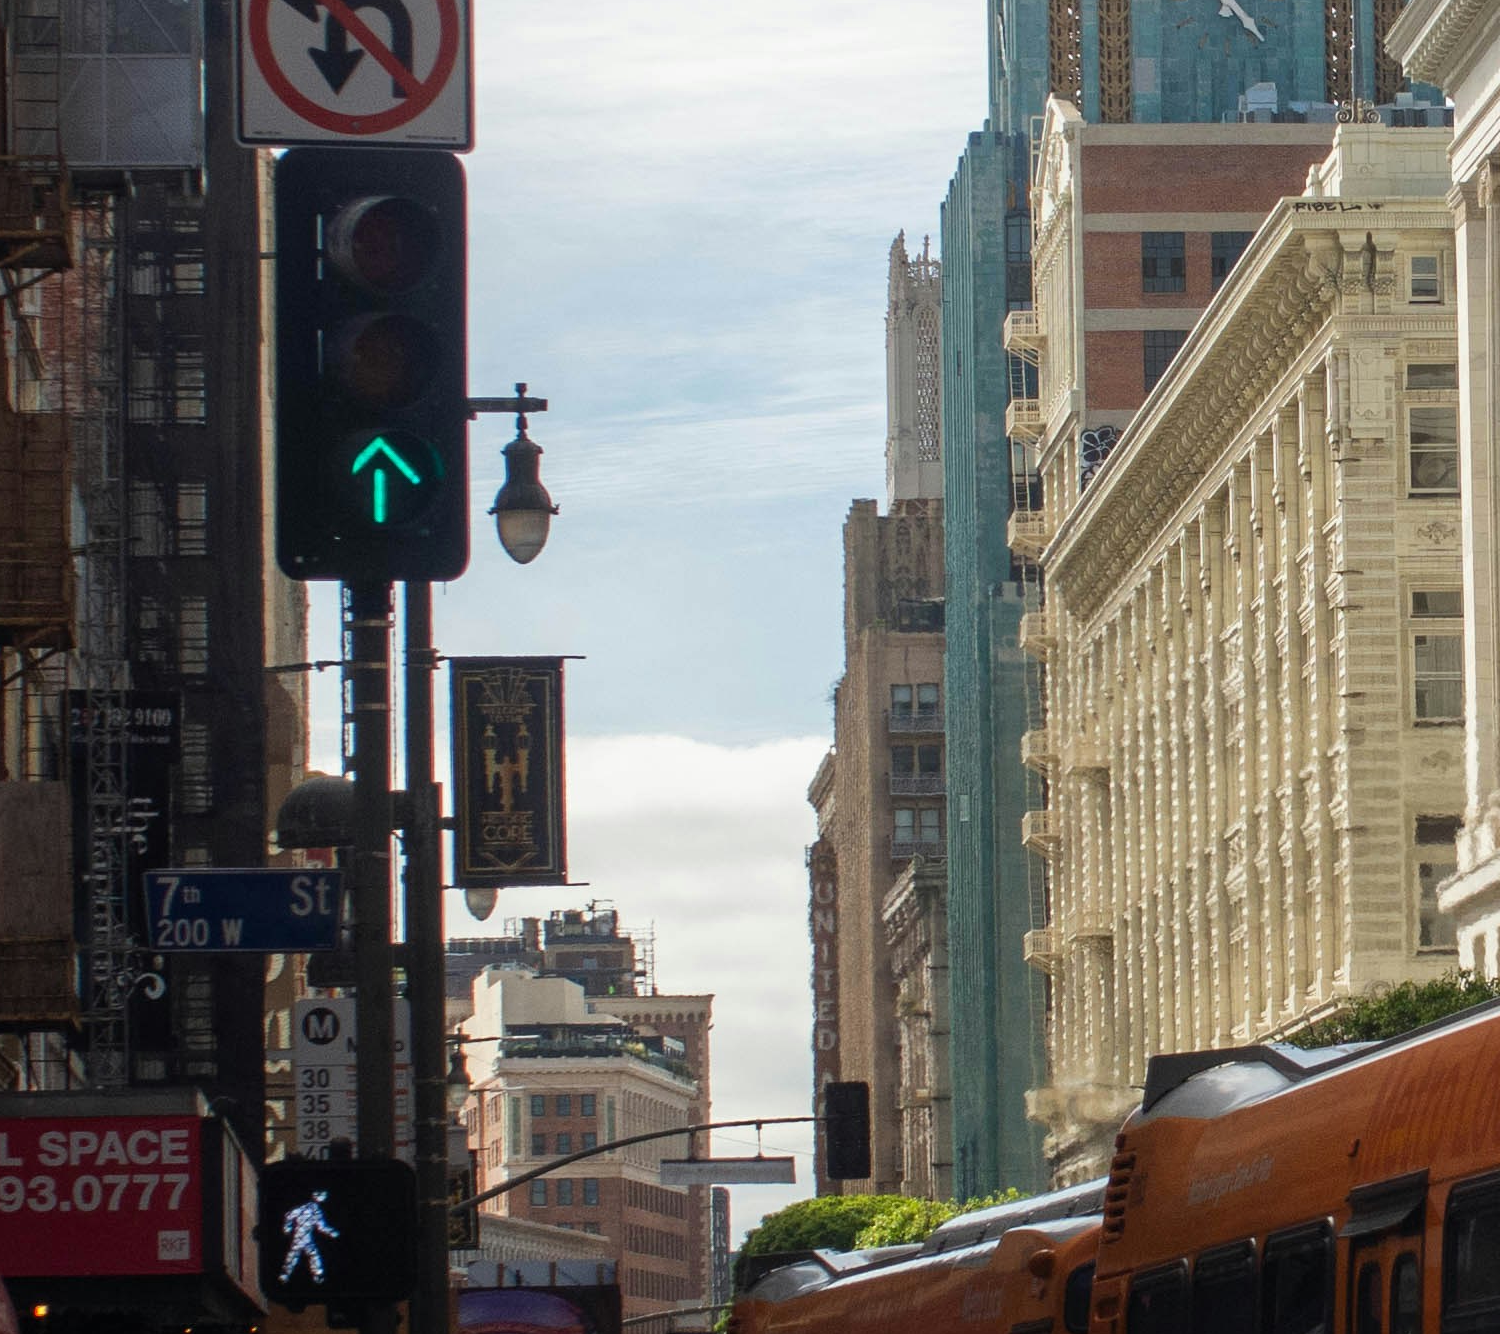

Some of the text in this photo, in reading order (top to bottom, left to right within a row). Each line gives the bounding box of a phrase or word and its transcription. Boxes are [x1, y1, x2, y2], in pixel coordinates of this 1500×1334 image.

[482, 825, 534, 841] CORE
[156, 875, 333, 917] 7th St
[156, 917, 244, 947] 200 W
[302, 1069, 330, 1088] 30
[302, 1095, 330, 1114] 35
[302, 1121, 330, 1140] 38
[37, 1130, 190, 1166] SPACE
[160, 1237, 187, 1252] RKF
